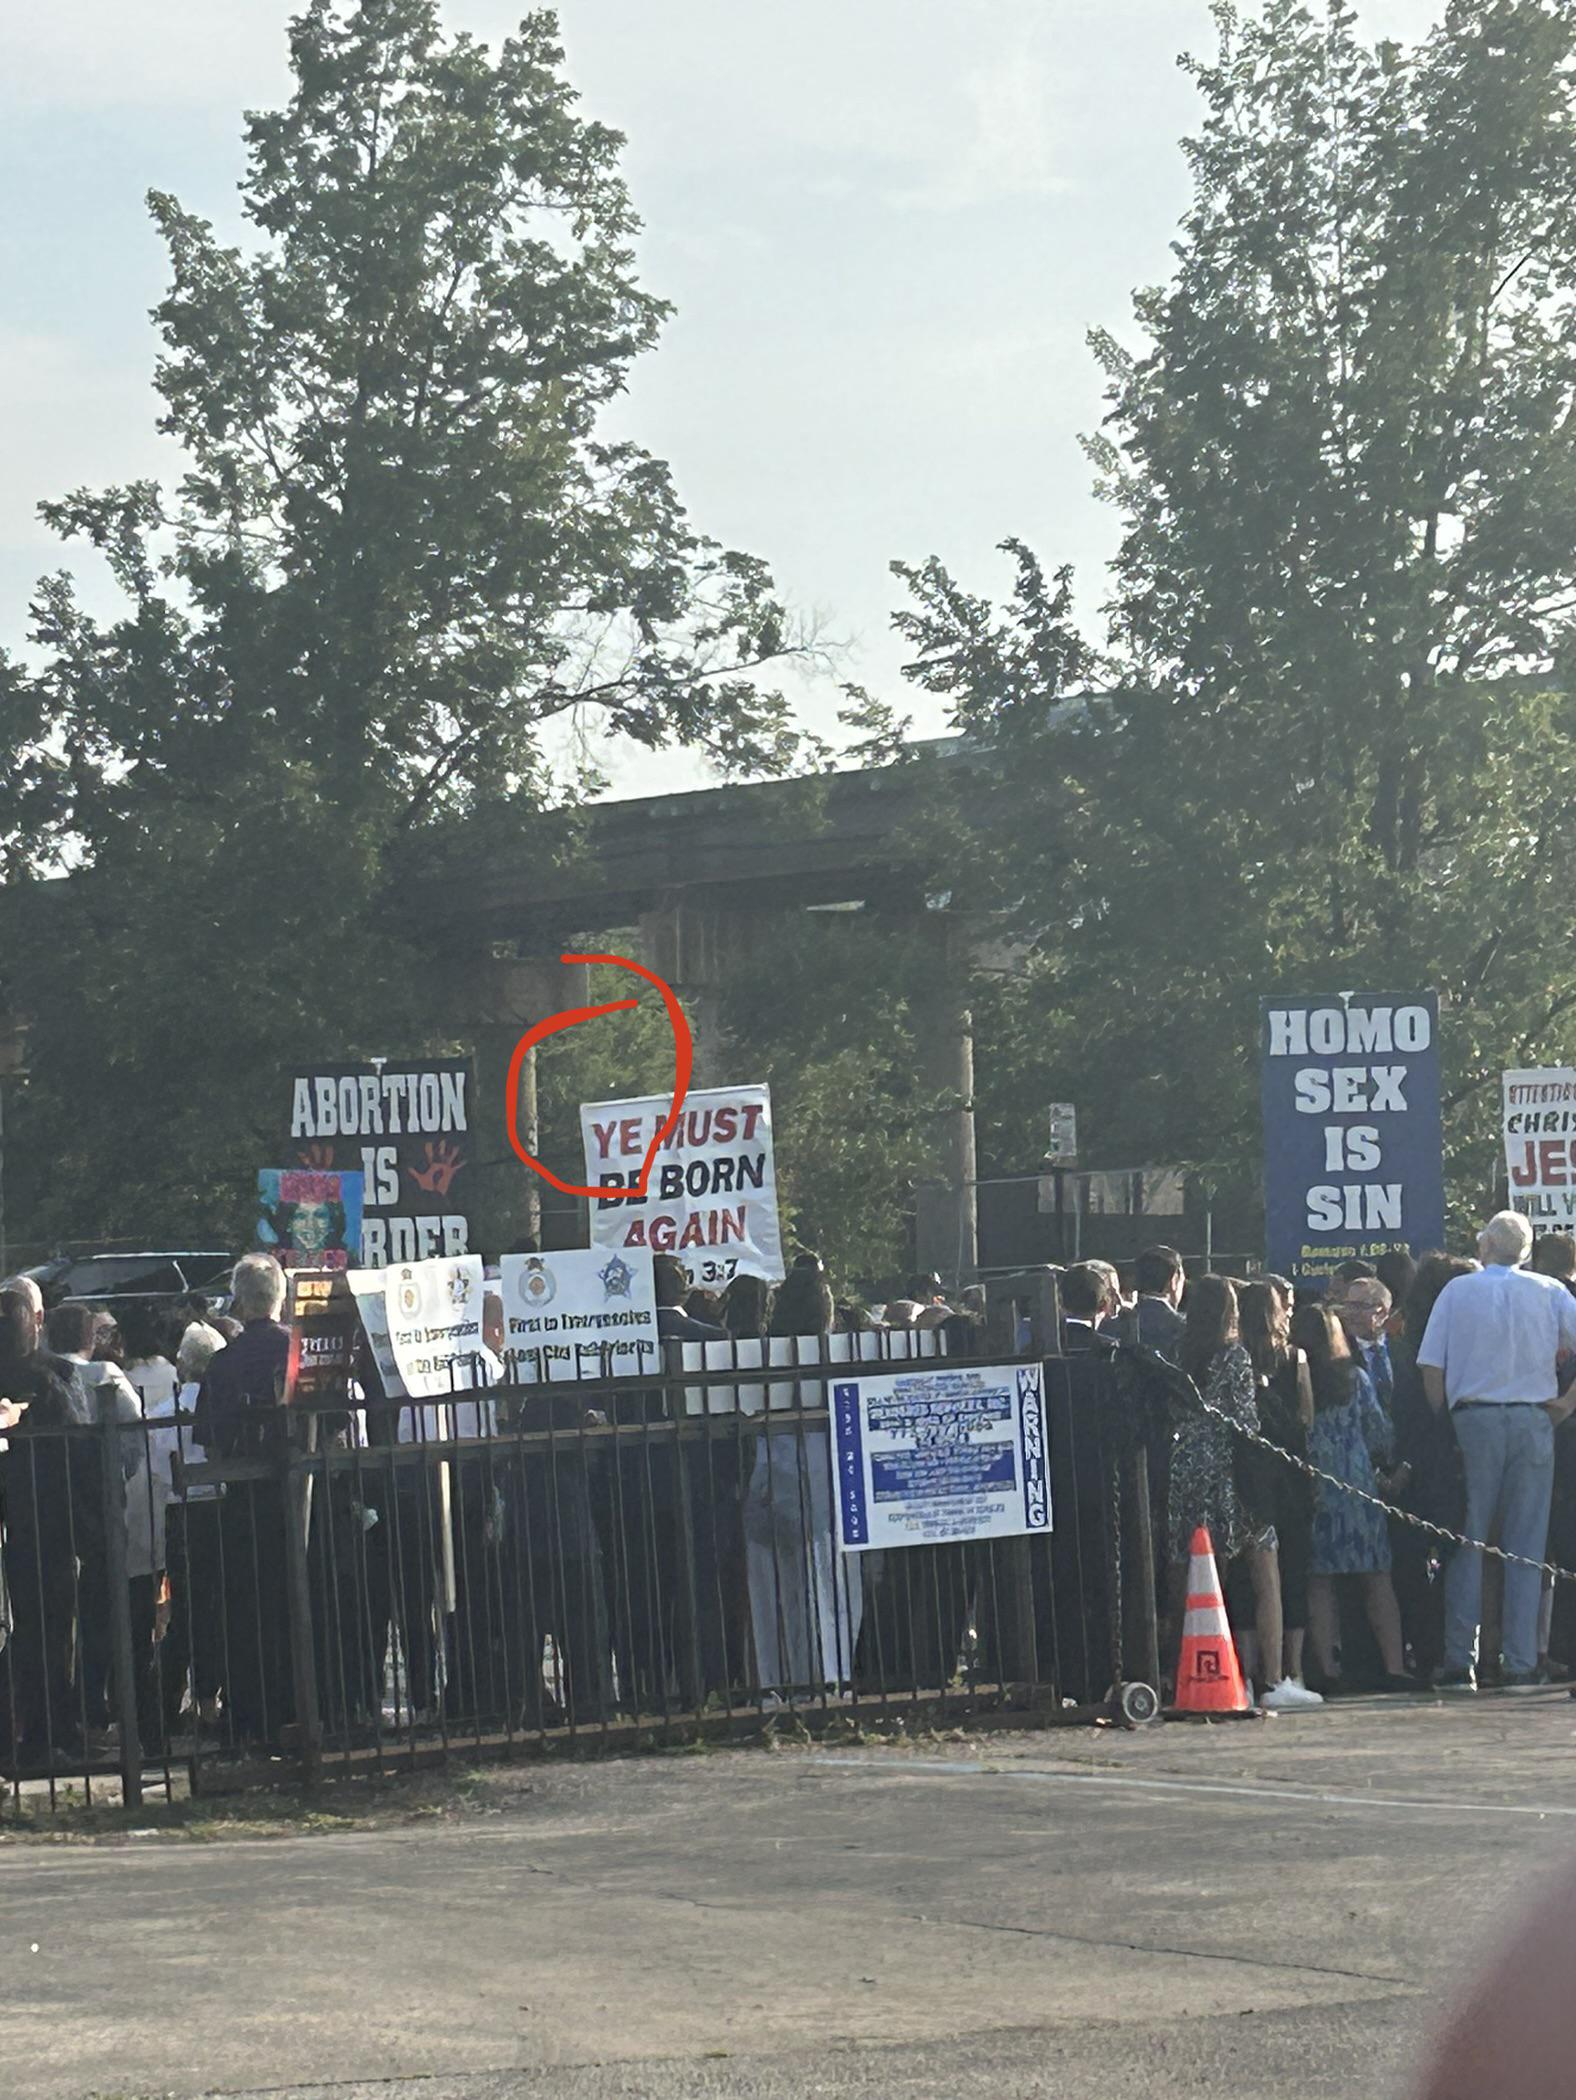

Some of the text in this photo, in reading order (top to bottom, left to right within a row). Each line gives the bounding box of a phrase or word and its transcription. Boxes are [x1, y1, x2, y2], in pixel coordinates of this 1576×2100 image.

[1268, 1006, 1431, 1055] HOMO
[290, 1072, 467, 1138] ABORTION
[1294, 1066, 1408, 1113] SEX
[591, 1104, 763, 1159] YE MUST
[1324, 1126, 1382, 1172] IS
[360, 1146, 399, 1206] IS
[597, 1153, 766, 1210] BE BORN
[1511, 1139, 1576, 1187] JES
[623, 1205, 746, 1252] AGAIN
[1306, 1183, 1402, 1232] SIN
[361, 1215, 470, 1268] RDER
[1017, 1367, 1048, 1529] WARNING
